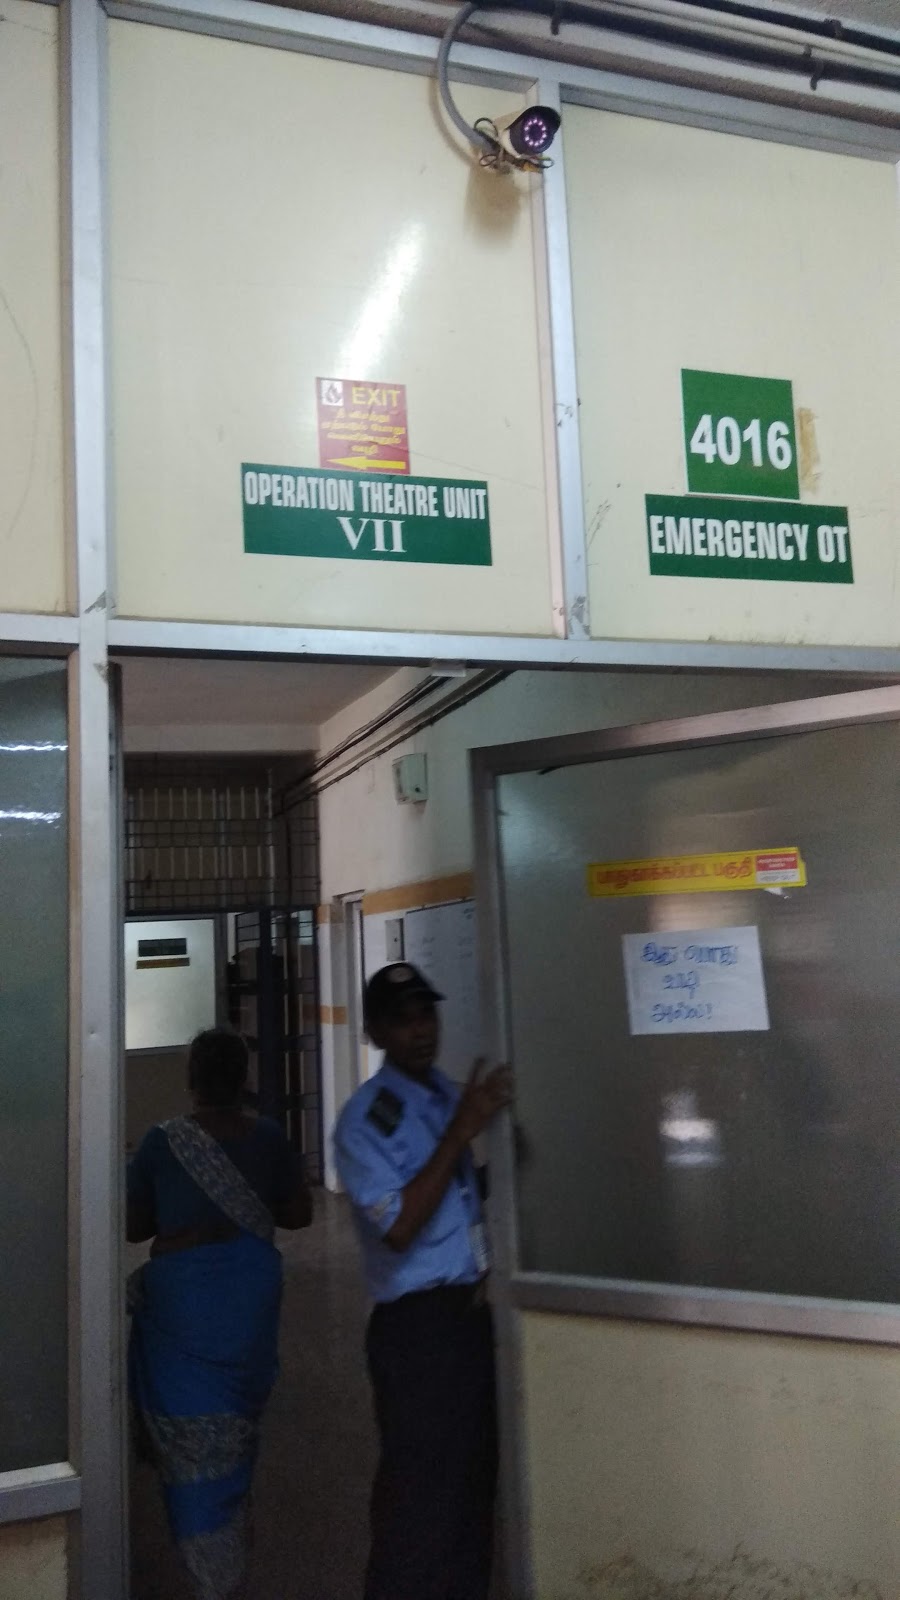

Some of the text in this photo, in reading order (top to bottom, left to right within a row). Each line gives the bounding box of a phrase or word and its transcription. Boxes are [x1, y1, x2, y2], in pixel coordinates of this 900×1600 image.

[351, 386, 401, 407] EXIT
[690, 414, 793, 470] 4016
[244, 471, 487, 520] OPERATION THEATRE UNIT
[336, 516, 407, 553] VII
[649, 515, 848, 563] EMERGENCY OT
